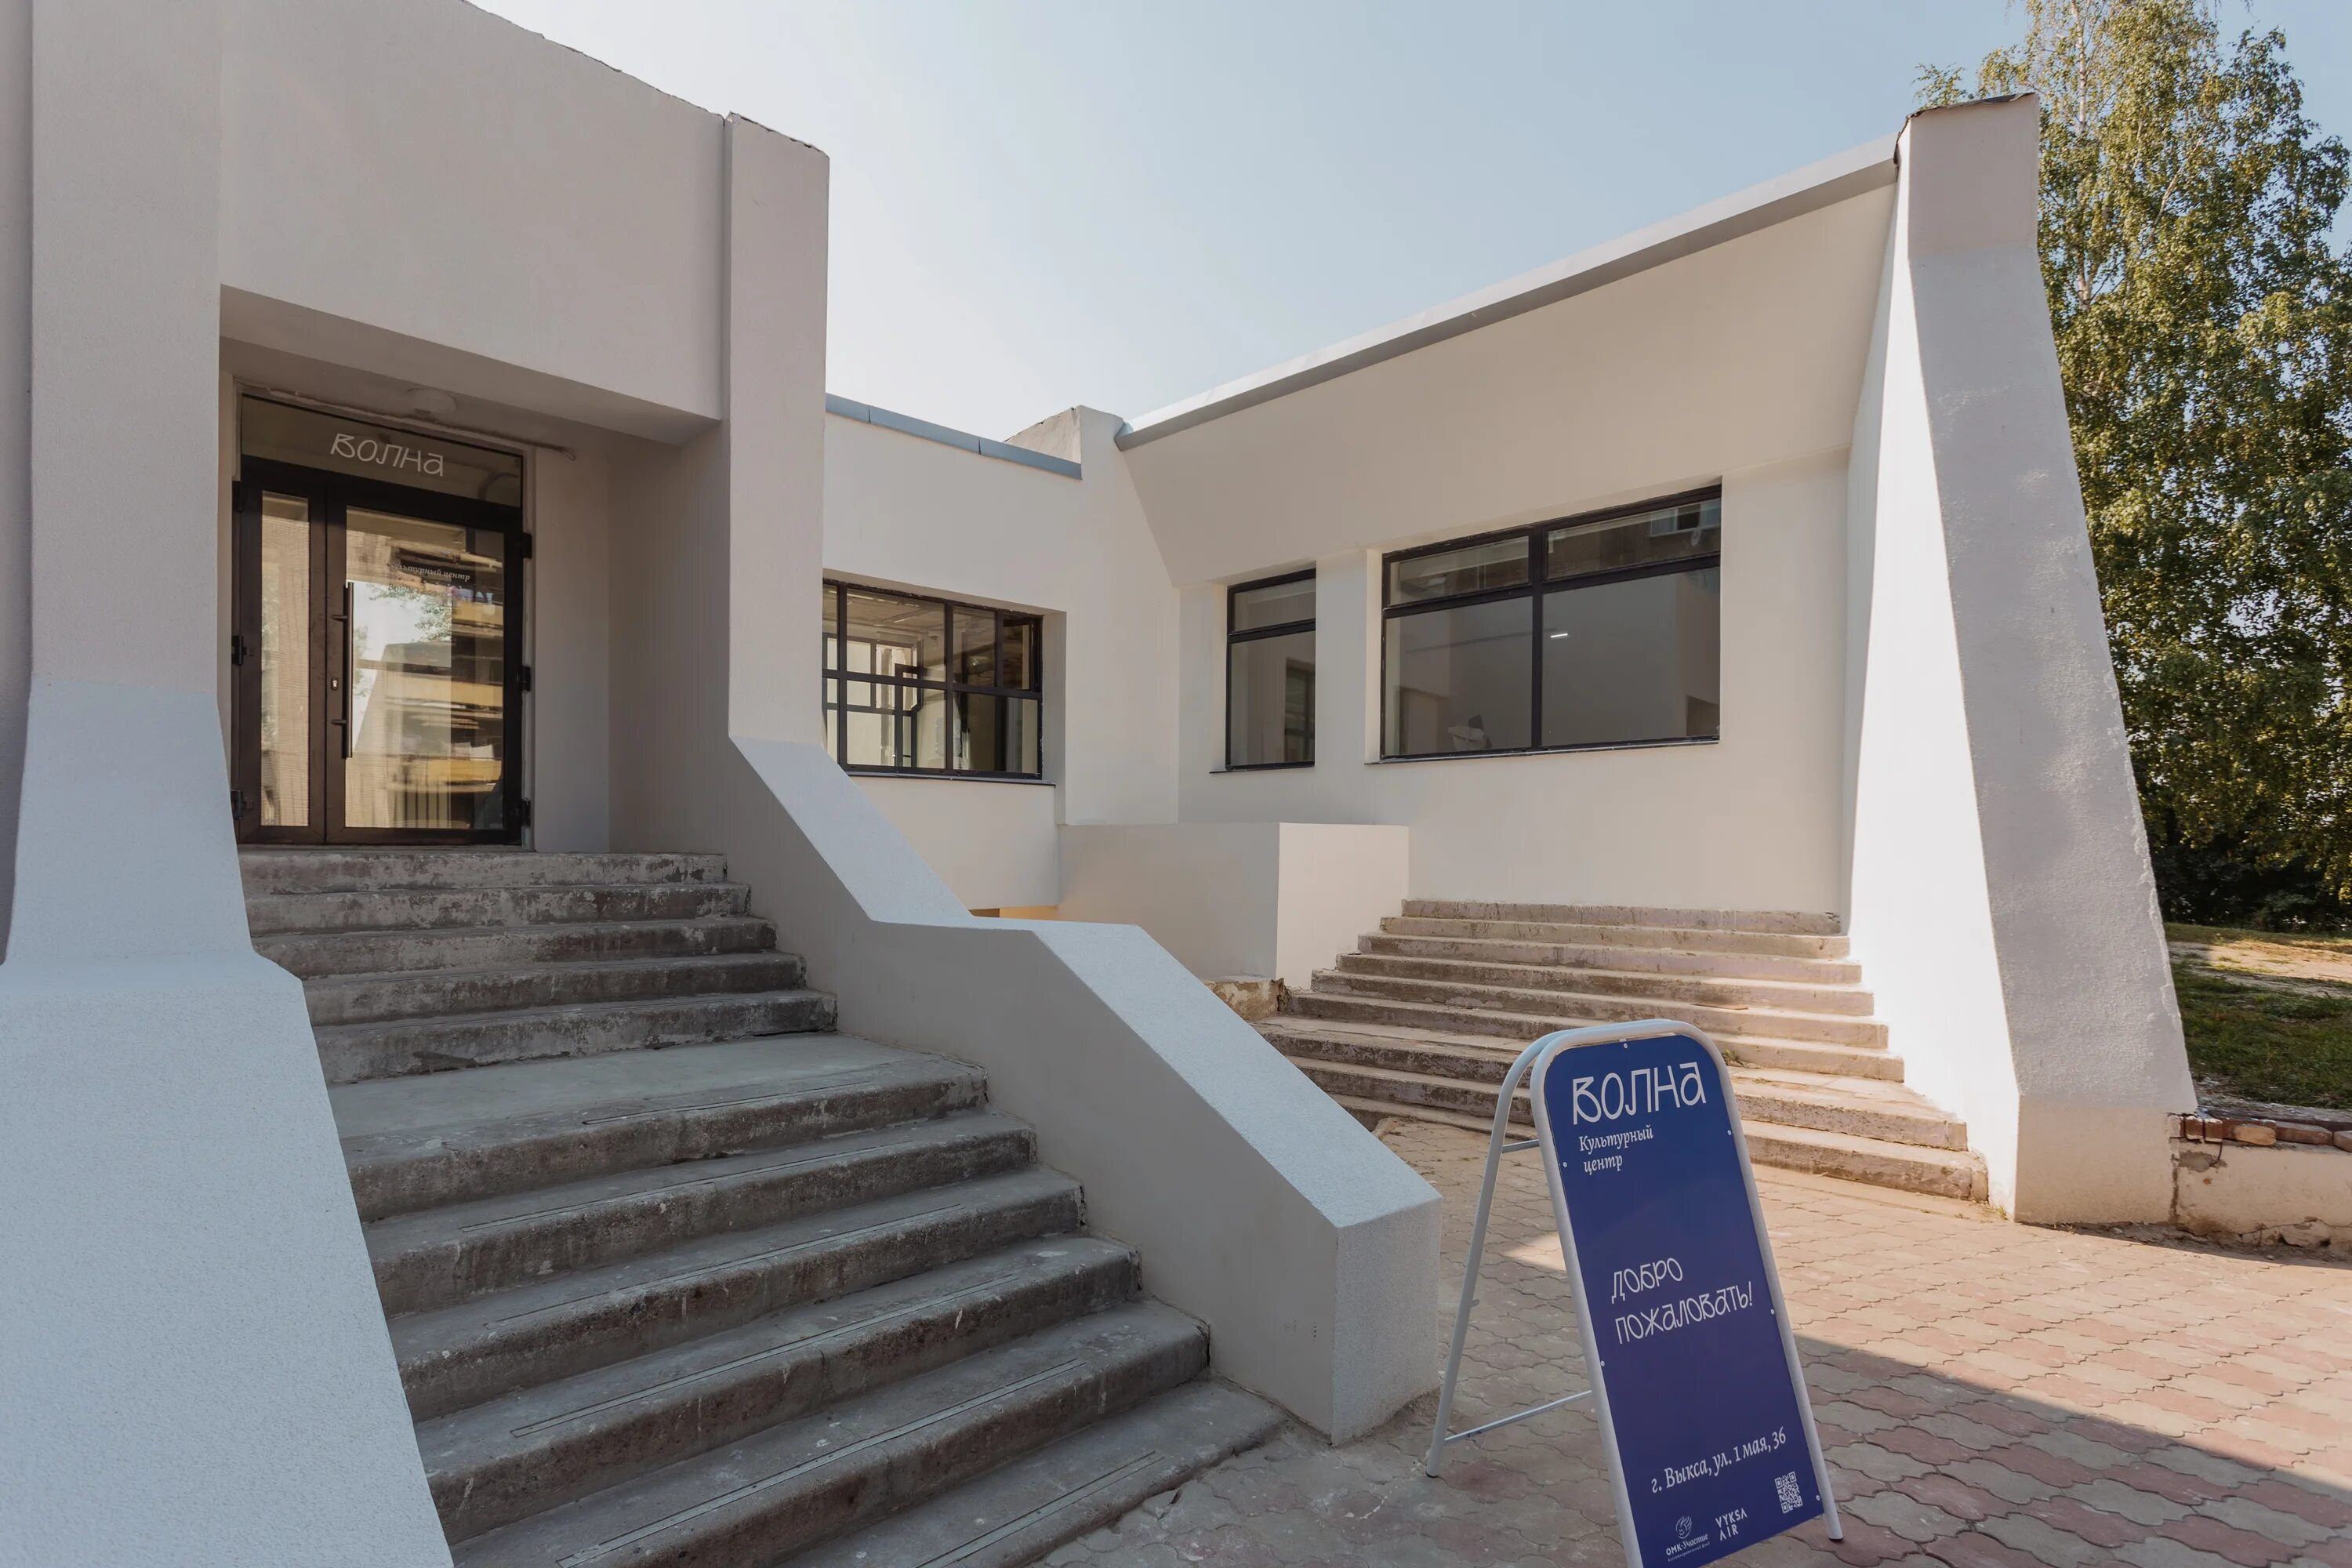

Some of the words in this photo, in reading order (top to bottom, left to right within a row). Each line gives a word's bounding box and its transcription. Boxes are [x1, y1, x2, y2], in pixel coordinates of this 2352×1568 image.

[443, 570, 470, 582] центр
[1579, 1124, 1653, 1155] Культурный
[1583, 1155, 1623, 1175] центр
[1651, 1478, 1662, 1494] г.
[1664, 1459, 1712, 1489] Выкса,
[1712, 1452, 1732, 1476] ул.
[1733, 1446, 1741, 1462] 1
[1742, 1436, 1771, 1459] мая,
[1772, 1426, 1786, 1449] 36
[1715, 1508, 1748, 1528] VYKSA
[1719, 1524, 1738, 1541] AIR
